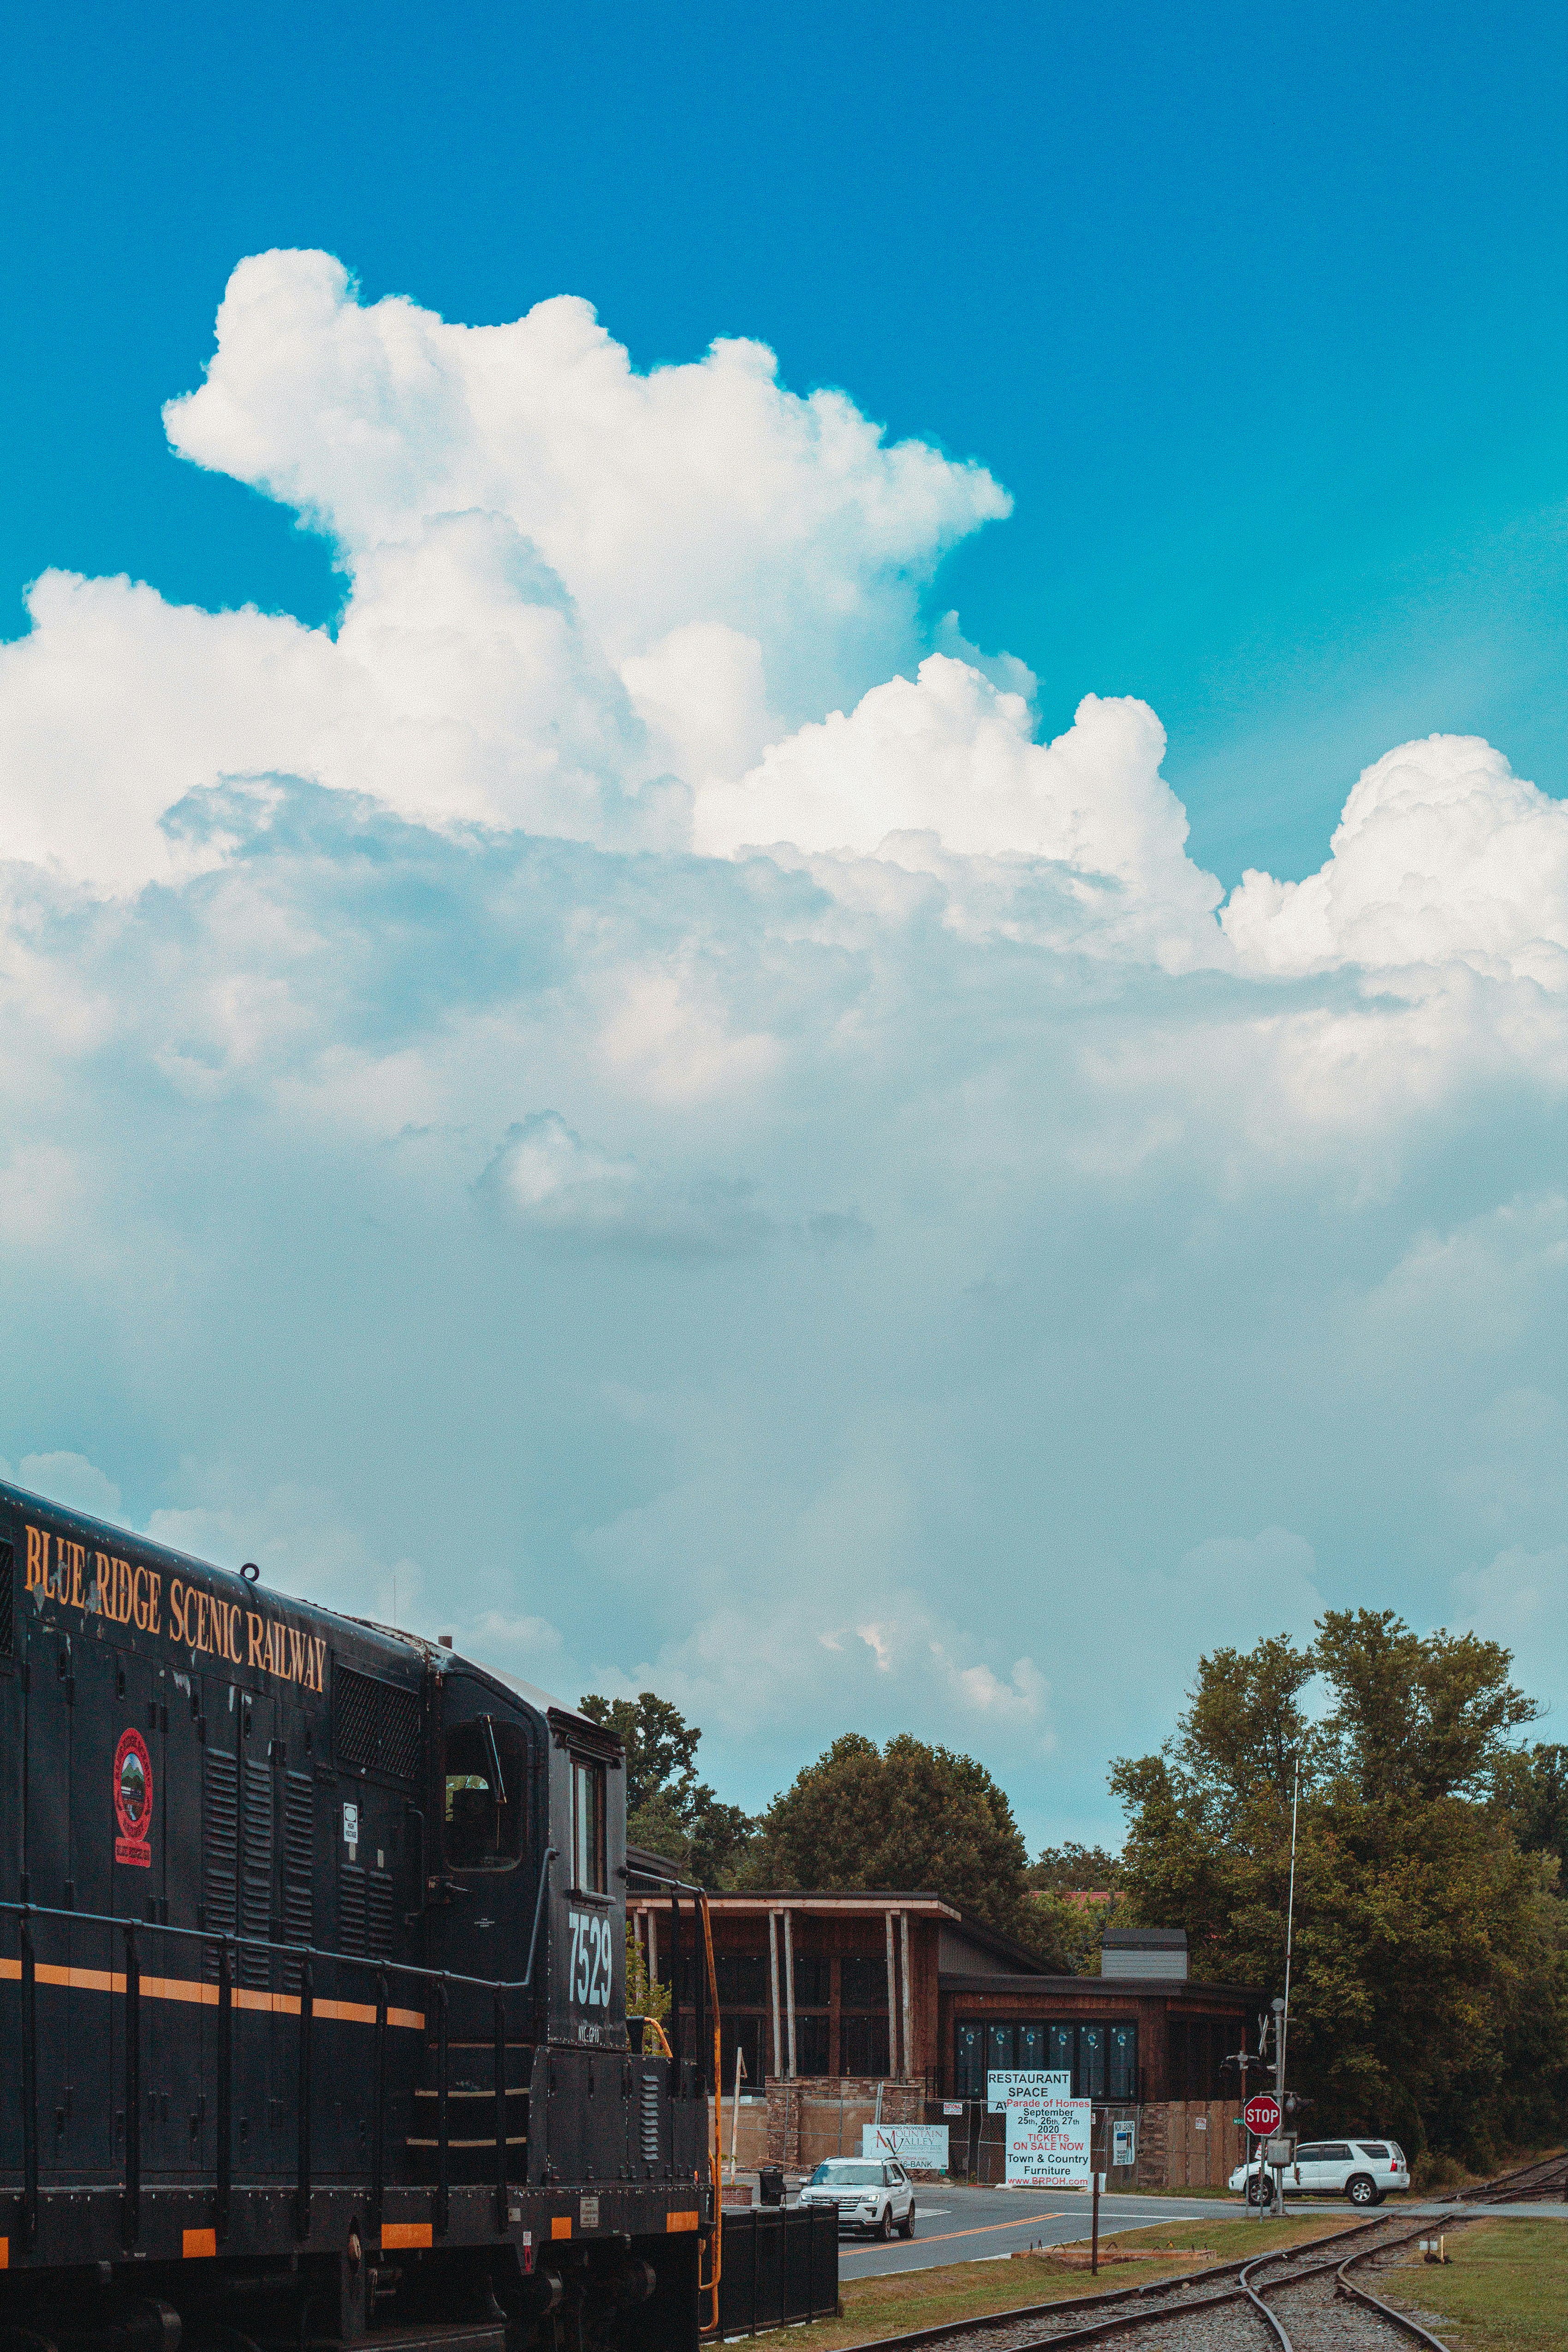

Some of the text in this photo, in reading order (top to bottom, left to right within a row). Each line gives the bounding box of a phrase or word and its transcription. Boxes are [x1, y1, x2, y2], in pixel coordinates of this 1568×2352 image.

[25, 1525, 326, 1693] BLUE RIDGE SCENIC RAILWAY
[345, 1829, 356, 1838] VOLTAGE
[569, 1912, 612, 2008] 7529
[989, 2074, 1069, 2084] RESTAURANT
[1009, 2088, 1048, 2097] SPACE
[1056, 2099, 1090, 2108] Homes
[1023, 2108, 1074, 2117] September
[1247, 2109, 1278, 2123] STOP
[1018, 2117, 1037, 2126] 25th,
[1041, 2117, 1060, 2125] 26th,
[1028, 2134, 1069, 2142] TICKETS
[1013, 2142, 1028, 2150] ON
[1061, 2143, 1084, 2151] NOW
[1007, 2154, 1088, 2165] Town & Country
[1024, 2166, 1070, 2175] Furniture
[1008, 2177, 1088, 2186] www.BRPOH.com
